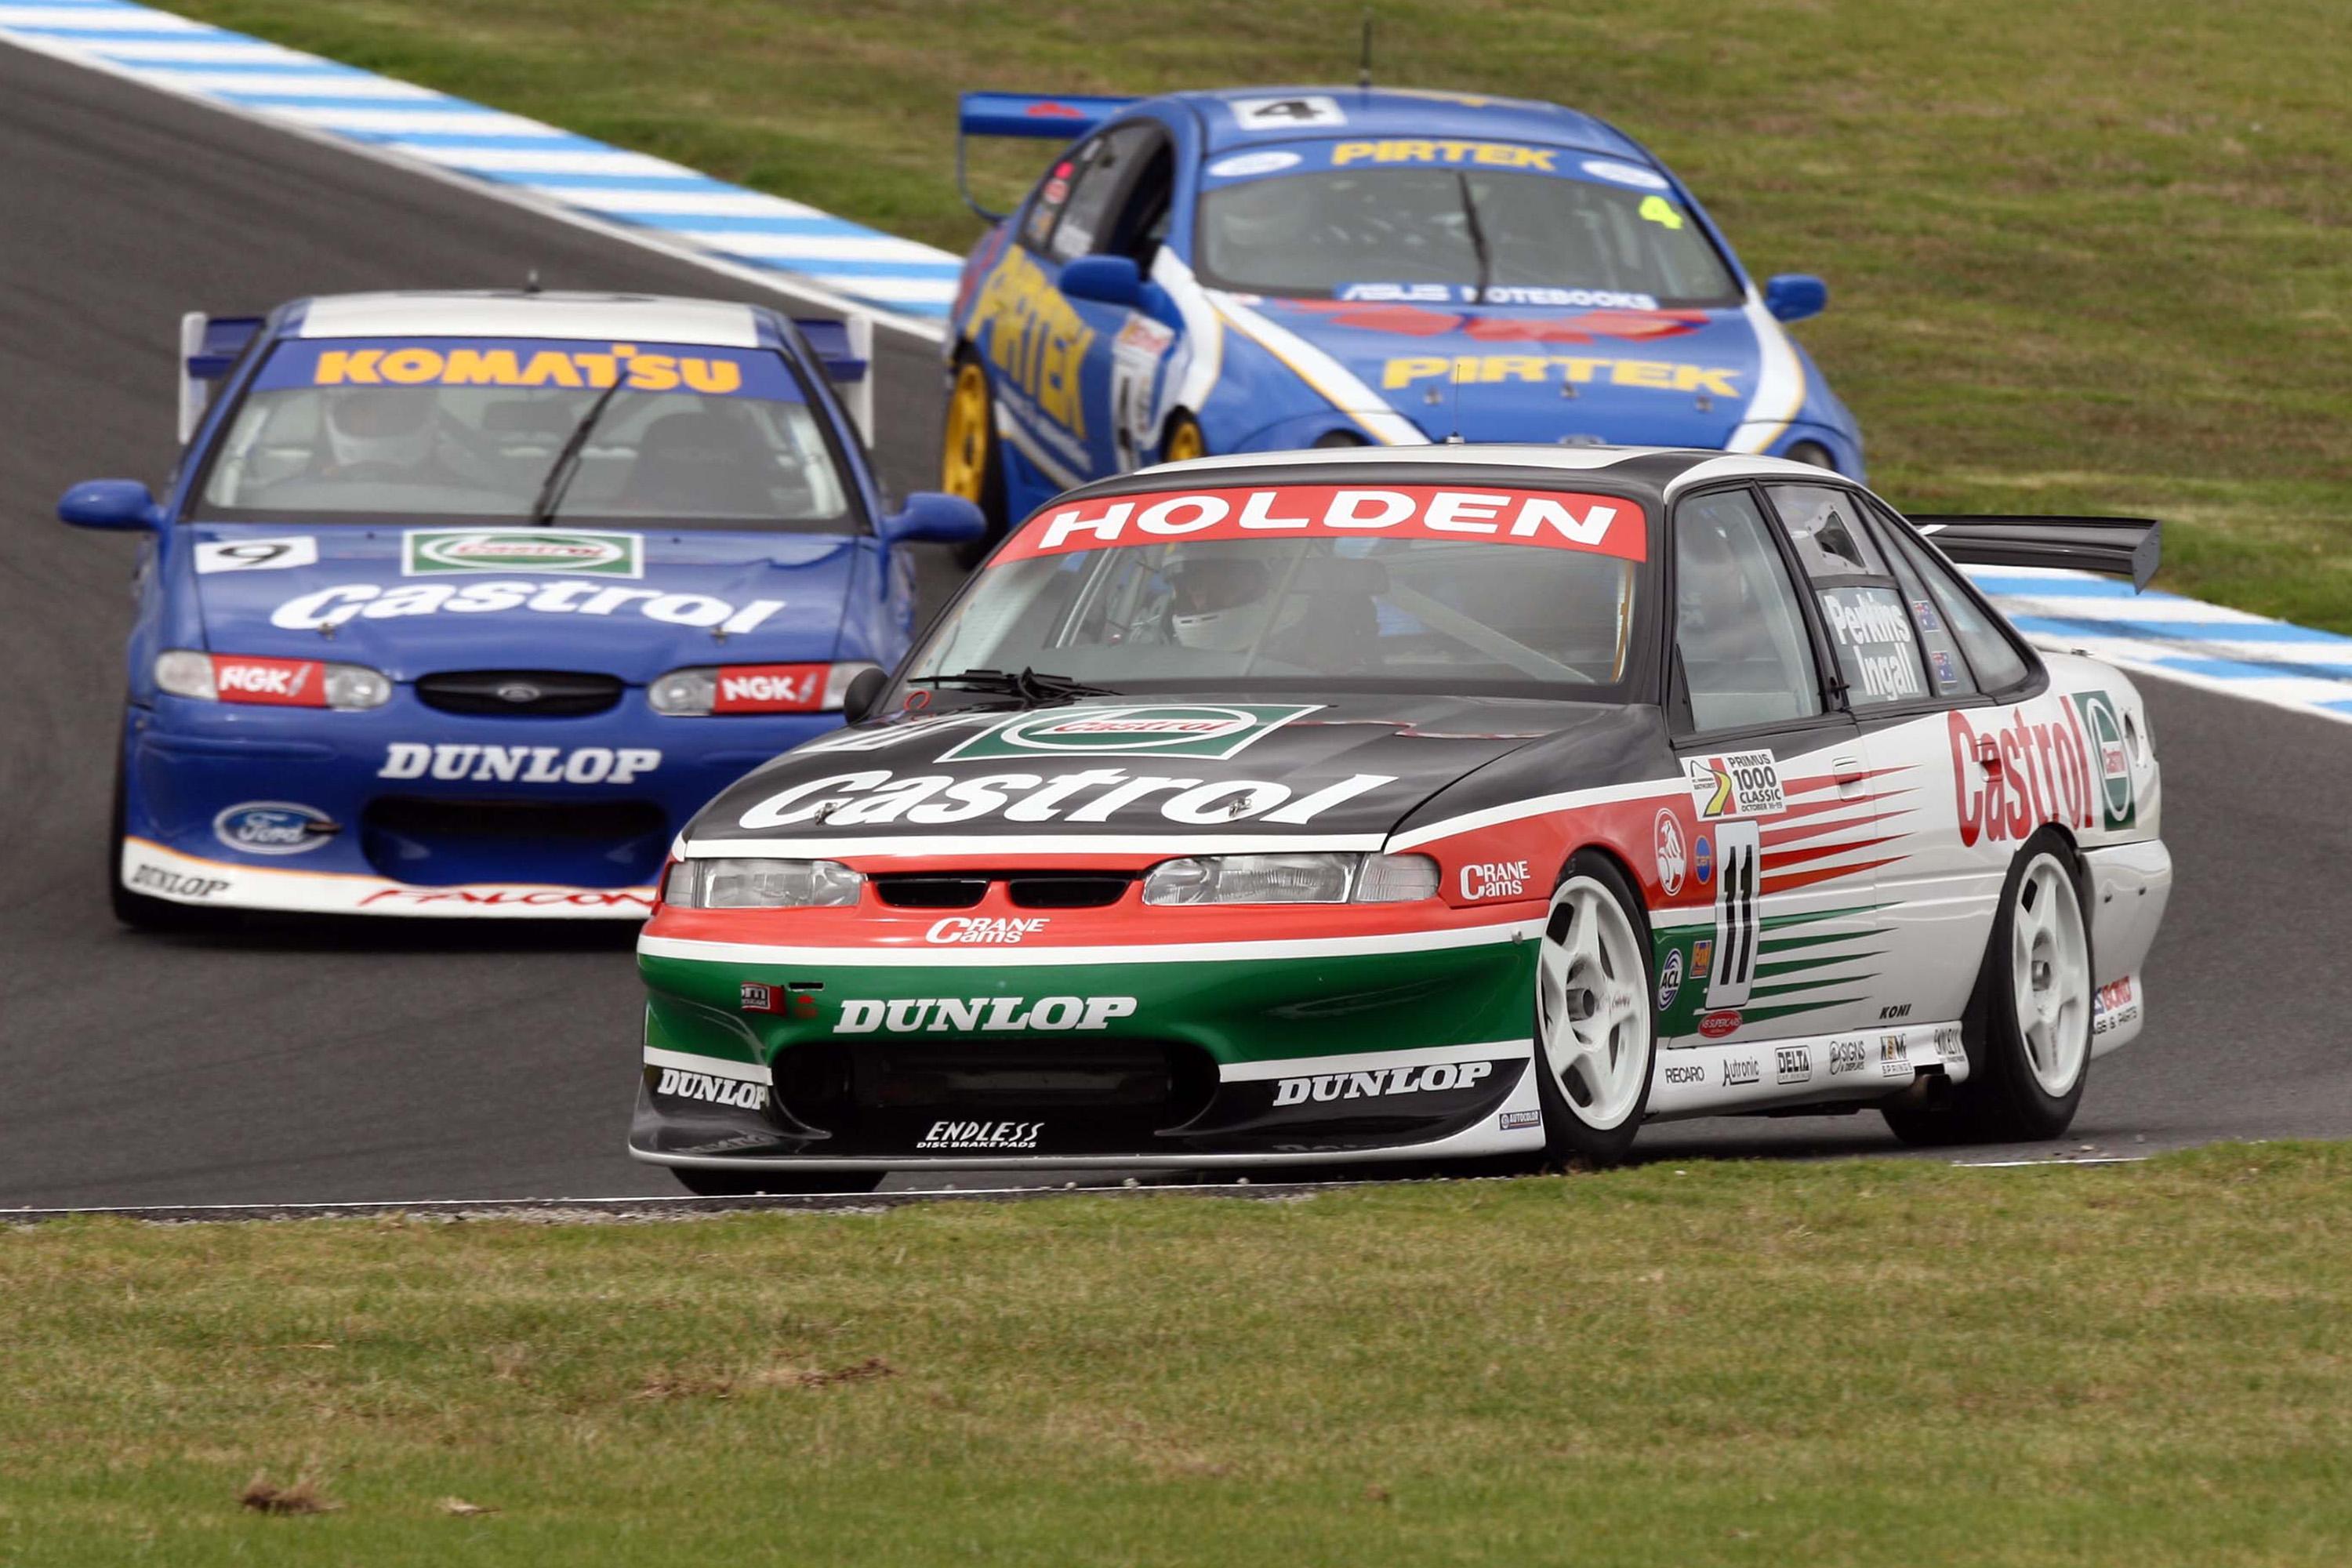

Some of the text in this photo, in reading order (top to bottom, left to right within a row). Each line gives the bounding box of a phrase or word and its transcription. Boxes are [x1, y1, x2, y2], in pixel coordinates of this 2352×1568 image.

[1252, 99, 1328, 120] 4
[1332, 141, 1559, 171] PIRTEK
[1341, 283, 1451, 302] ASUS
[315, 343, 742, 393] KOMATSU
[1381, 356, 1744, 397] PIRTEK
[1038, 490, 1617, 550] HOLDEN
[216, 543, 292, 566] 9
[270, 580, 786, 633] Castrol
[1824, 592, 1911, 644] Perkins
[218, 665, 292, 695] NGK
[1853, 642, 1919, 701] Ingall
[722, 675, 797, 702] NGK
[1054, 720, 1240, 731] Castrol
[377, 742, 663, 784] DUNLOP
[1727, 753, 1771, 768] PRIMUS
[1947, 695, 2094, 848] Castrol
[1733, 766, 1777, 791] 1000
[739, 768, 1399, 829] Castrol
[1740, 788, 1782, 804] CLASSIC
[237, 811, 306, 843] Ford
[1460, 860, 1531, 900] CRANE
[925, 916, 1051, 944] CRANE
[1720, 844, 1753, 985] 11
[1660, 971, 1679, 989] ACL
[833, 996, 1137, 1033] DUNLOP
[1879, 1004, 1912, 1019] KONI
[1665, 1066, 1705, 1083] RECARO
[1722, 1055, 1760, 1087] Autronic
[1777, 1051, 1809, 1073] DELTA
[658, 1069, 771, 1110] DUNLOP
[1272, 1061, 1492, 1106] DUNLOP
[925, 1121, 1045, 1142] ENDLESS
